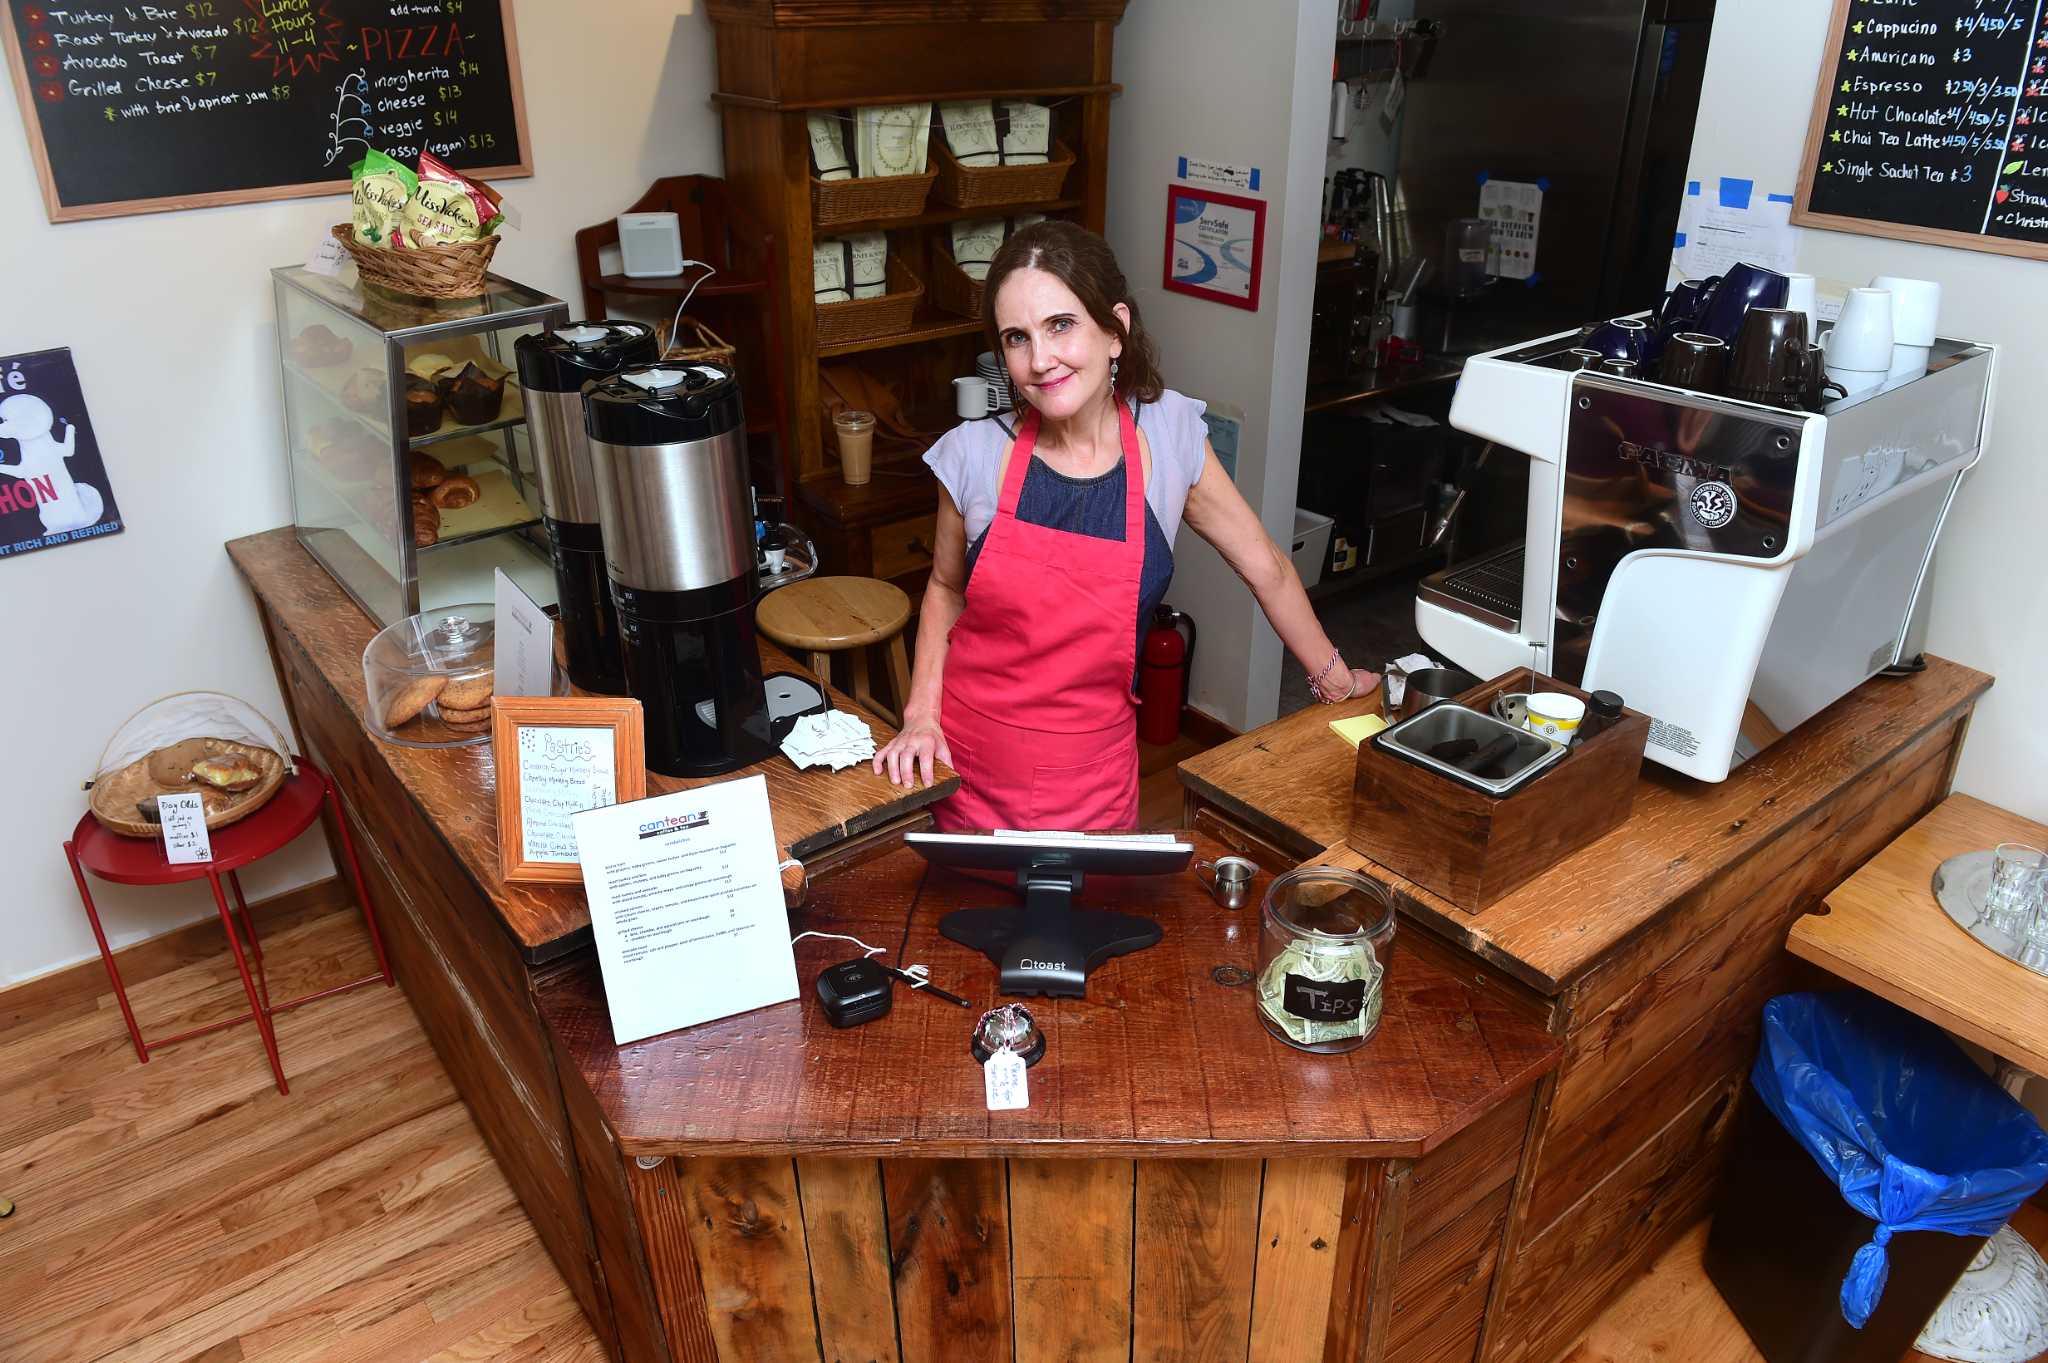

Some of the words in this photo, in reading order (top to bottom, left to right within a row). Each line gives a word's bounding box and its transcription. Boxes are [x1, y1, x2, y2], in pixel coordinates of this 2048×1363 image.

[49, 10, 114, 30] Turkey
[185, 2, 219, 20] $12
[389, 6, 409, 16] add
[447, 2, 464, 14] $4
[53, 33, 104, 48] Roast
[110, 30, 157, 47] Turkey
[175, 24, 229, 40] Avocado
[233, 17, 259, 34] $12
[271, 11, 317, 35] Hours
[1866, 18, 1938, 39] Cappucino
[361, 22, 465, 62] PIZZA
[63, 53, 128, 72] Avocado
[138, 51, 185, 67] Toast
[191, 44, 217, 60] $7
[458, 60, 480, 77] $14
[1858, 46, 1936, 67] Americano
[1952, 48, 1972, 63] $3
[68, 78, 123, 97] Grilled
[134, 76, 191, 93] Cheese
[194, 72, 217, 87] $7
[1853, 75, 1923, 95] Espresso
[120, 104, 150, 119] with
[156, 100, 182, 115] brie
[197, 93, 240, 112] apricot
[246, 89, 269, 105] jam
[271, 85, 290, 99] $8
[377, 94, 426, 112] cheese
[438, 86, 463, 101] $13
[379, 118, 424, 138] veggie
[433, 111, 458, 126] $14
[1849, 101, 1879, 120] Hot
[1885, 105, 1948, 126] Chocolate
[383, 145, 418, 158] rosso
[468, 134, 496, 149] $13
[1843, 130, 1872, 145] Chai
[1878, 131, 1900, 146] Tea
[1905, 131, 1942, 149] Latte
[1834, 159, 1874, 183] Single
[1923, 166, 1944, 183] Tea
[417, 213, 433, 229] SEA
[434, 221, 455, 236] SALT
[13, 536, 43, 553] RICH
[44, 532, 70, 547] AND
[71, 522, 119, 541] REFINED
[544, 733, 592, 755] Pastries
[161, 801, 178, 814] Day
[639, 813, 697, 833] cantean
[1033, 960, 1067, 971] toast
